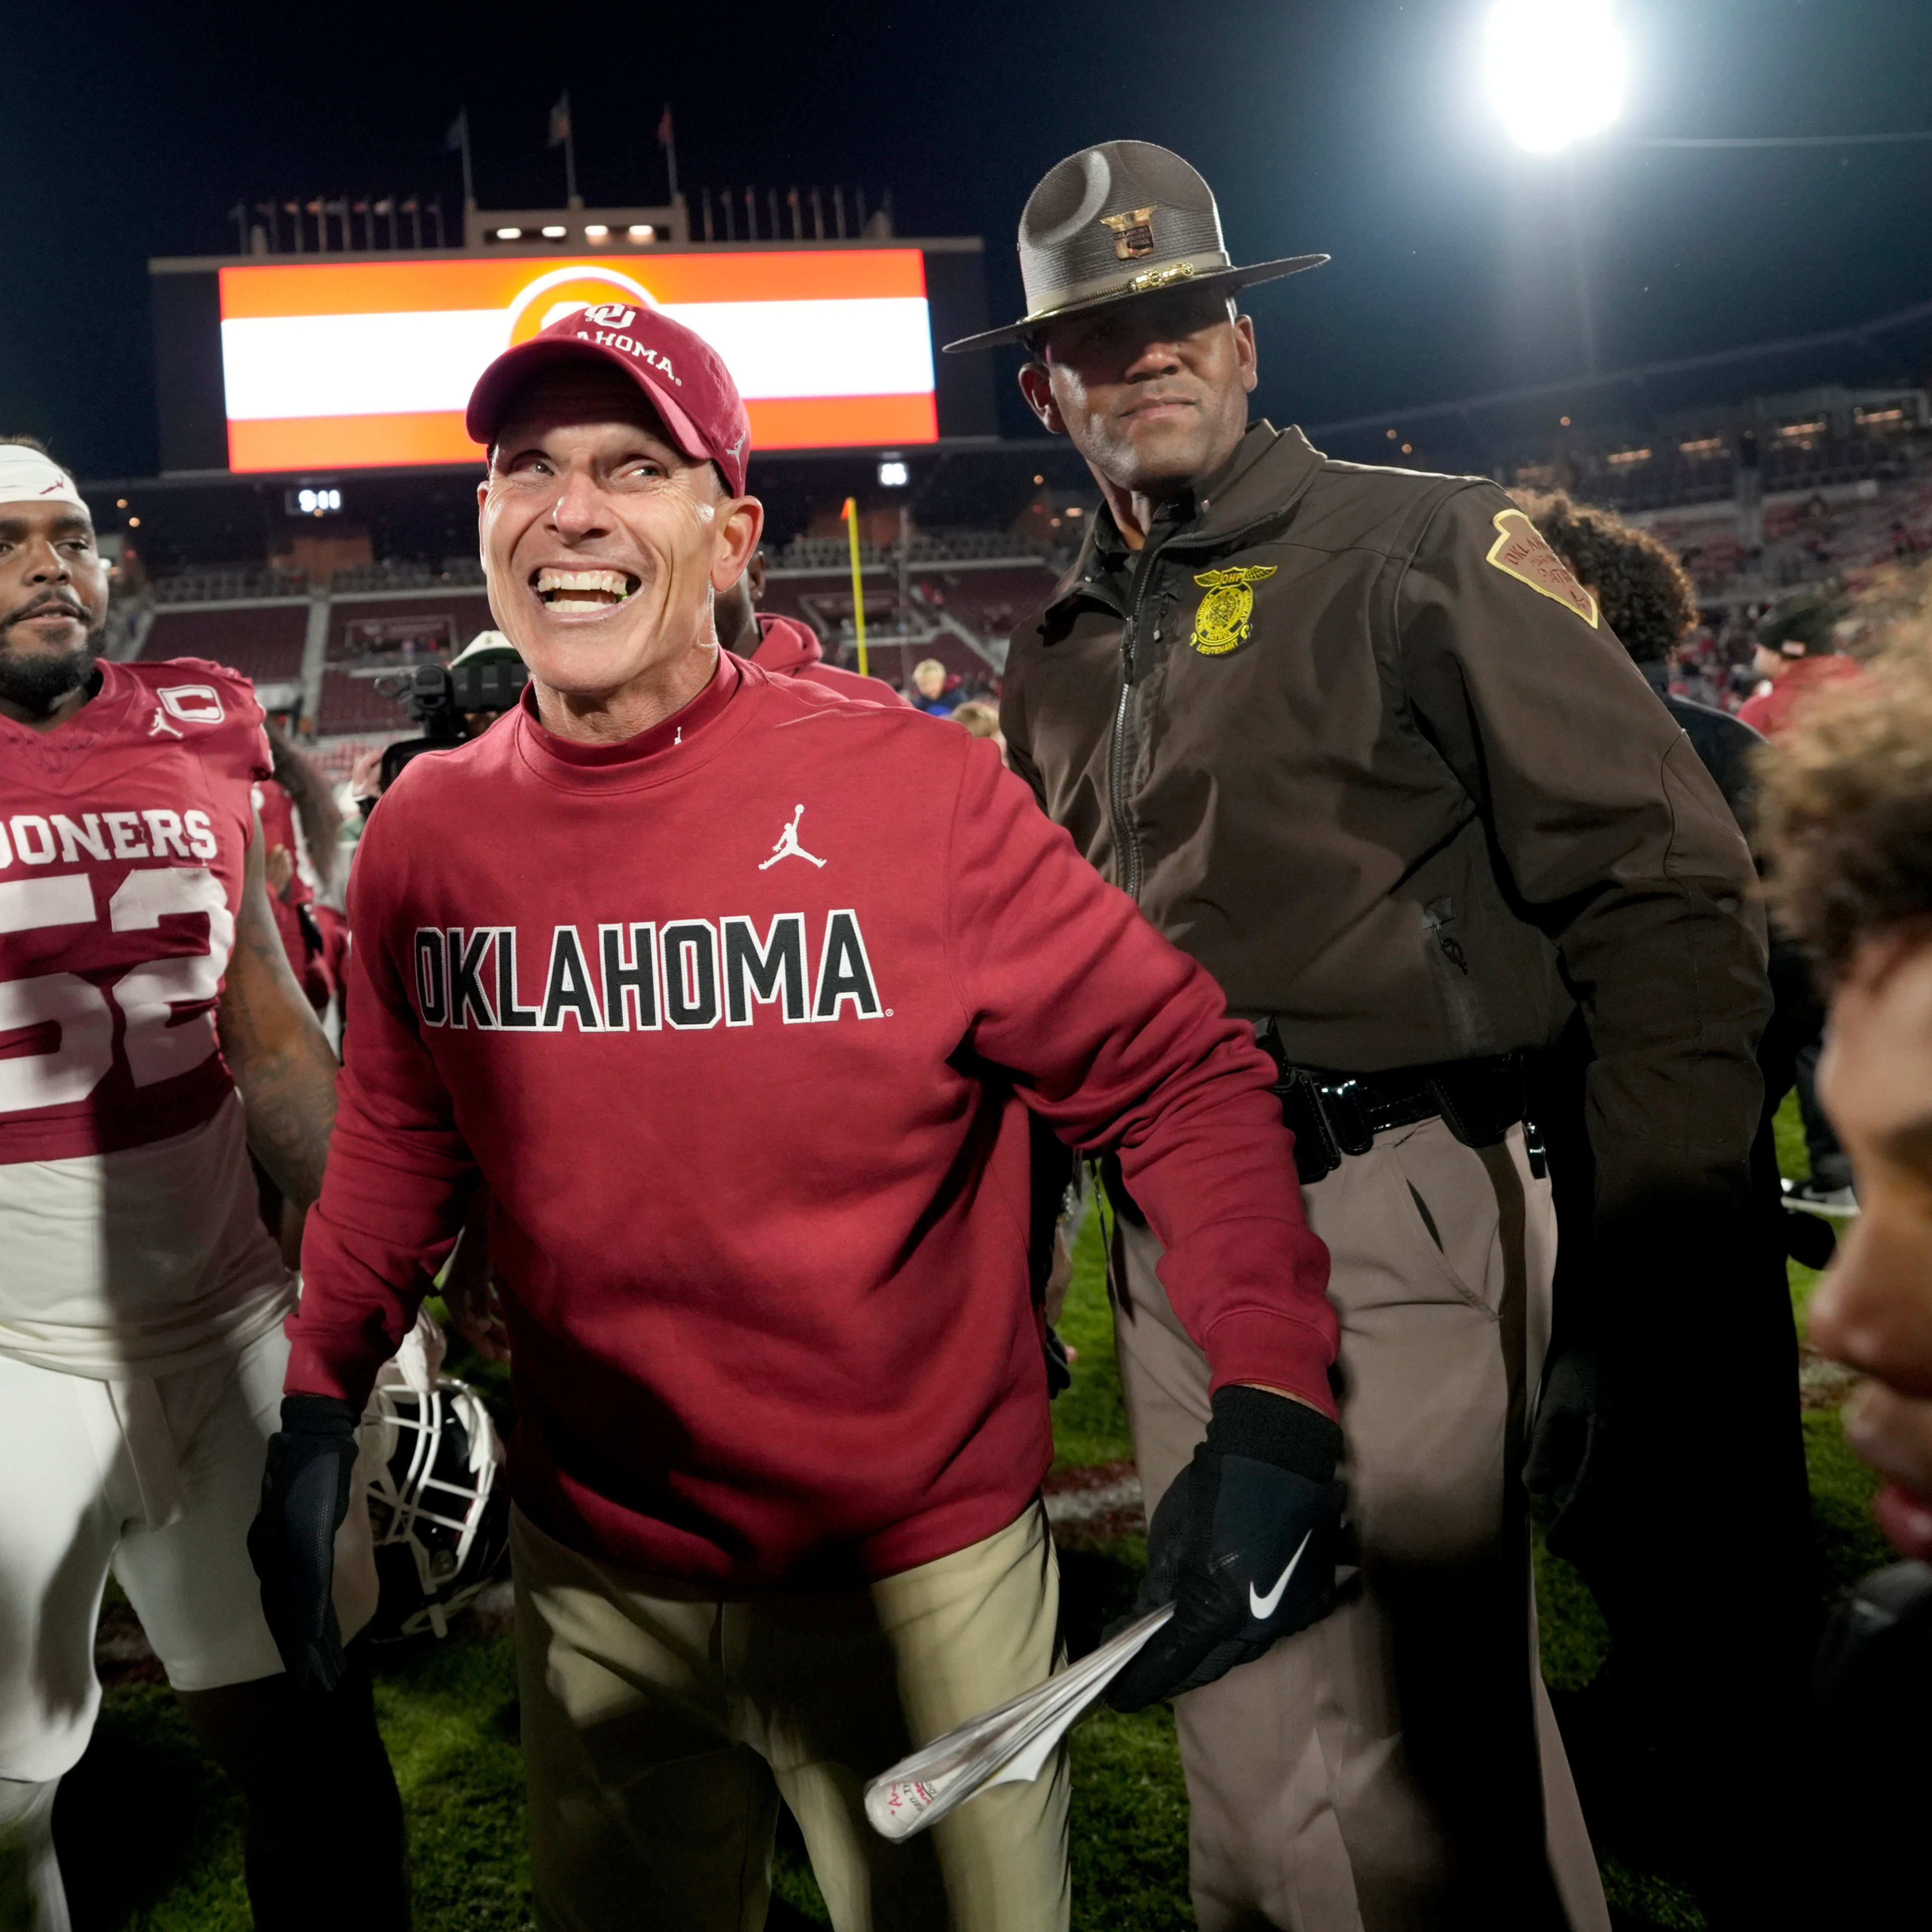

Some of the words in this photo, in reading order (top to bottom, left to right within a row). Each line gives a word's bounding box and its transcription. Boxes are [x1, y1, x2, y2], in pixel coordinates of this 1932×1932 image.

[1222, 573, 1243, 584] OHP
[0, 810, 218, 869] ONERS
[0, 867, 233, 1112] 52
[414, 909, 884, 1031] OKLAHOMA
